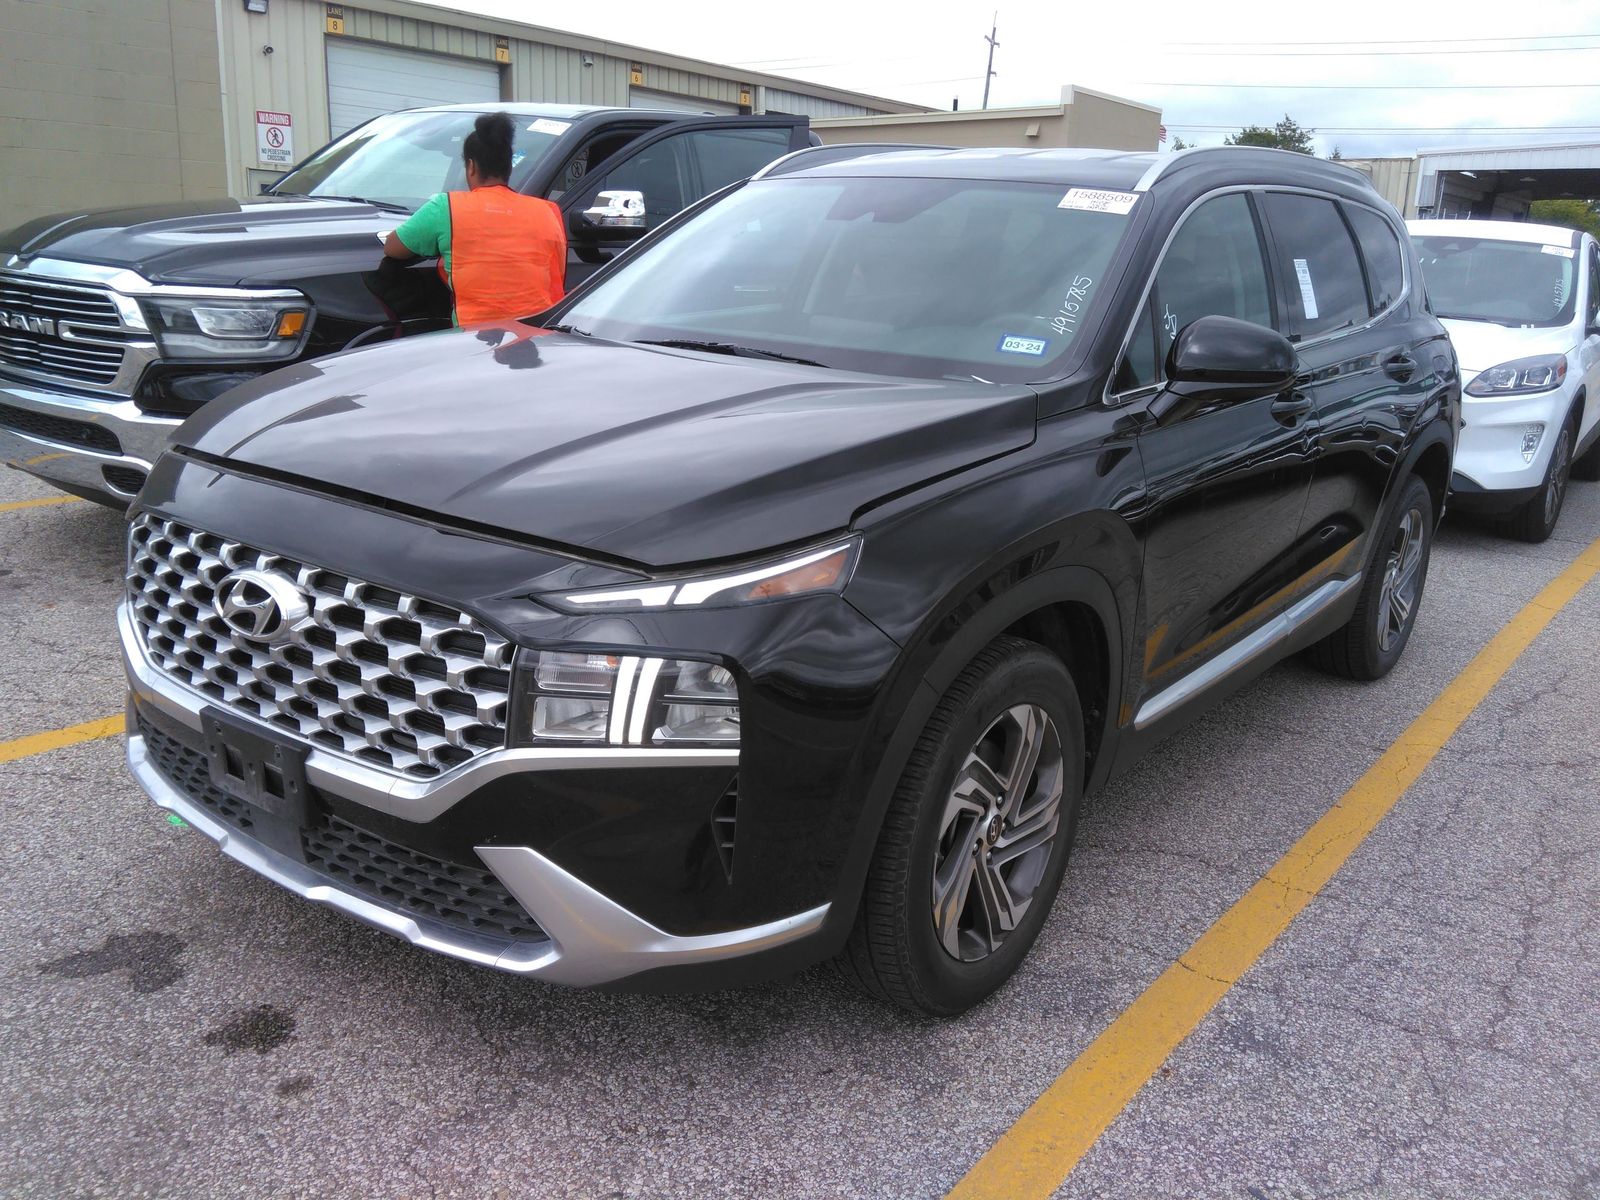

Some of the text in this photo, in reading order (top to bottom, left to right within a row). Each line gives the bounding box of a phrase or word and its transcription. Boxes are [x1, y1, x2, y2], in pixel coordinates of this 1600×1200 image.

[332, 20, 338, 31] 8
[258, 111, 290, 126] WARNING
[267, 148, 291, 156] PEDESTRIAN
[266, 154, 287, 162] CROSSING
[1072, 190, 1133, 203] 1588509
